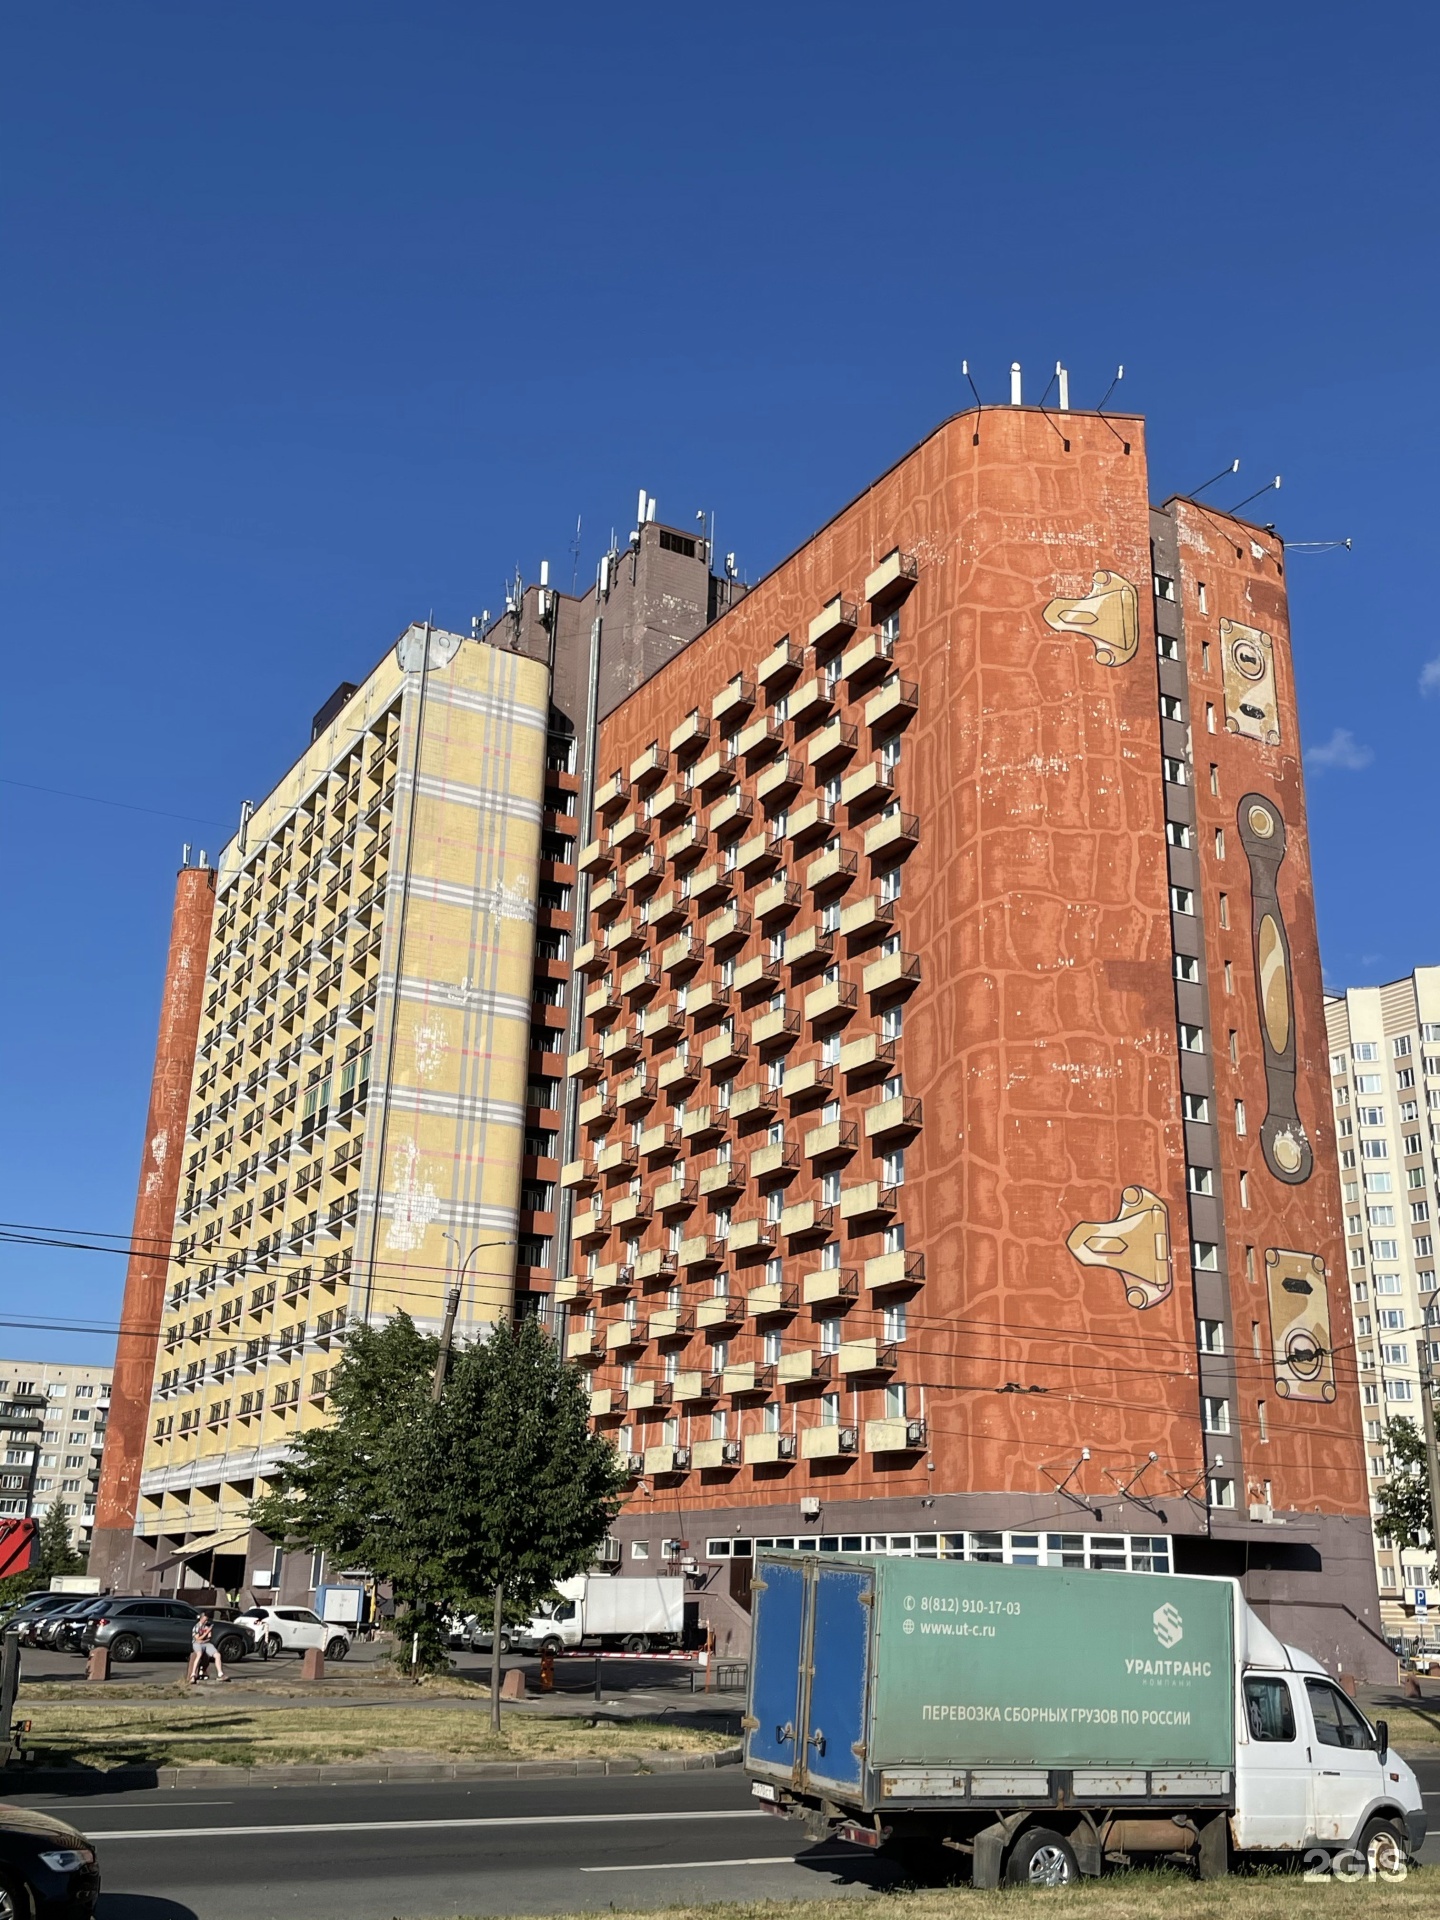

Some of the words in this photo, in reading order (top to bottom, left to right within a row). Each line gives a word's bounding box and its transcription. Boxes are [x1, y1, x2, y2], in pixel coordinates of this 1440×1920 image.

[920, 1596, 959, 1615] 8(812)
[962, 1599, 1021, 1616] 910-17-03
[920, 1622, 996, 1637] www.ut-c.ru
[1124, 1658, 1212, 1677] УРАЛТРАНС
[922, 1705, 1002, 1721] ПЕРЕВОЗКА
[1004, 1707, 1068, 1722] СБОРНЫХ
[1071, 1708, 1119, 1724] ГРУЗОВ
[1121, 1709, 1139, 1725] ПО
[1142, 1710, 1191, 1726] РОССИИ
